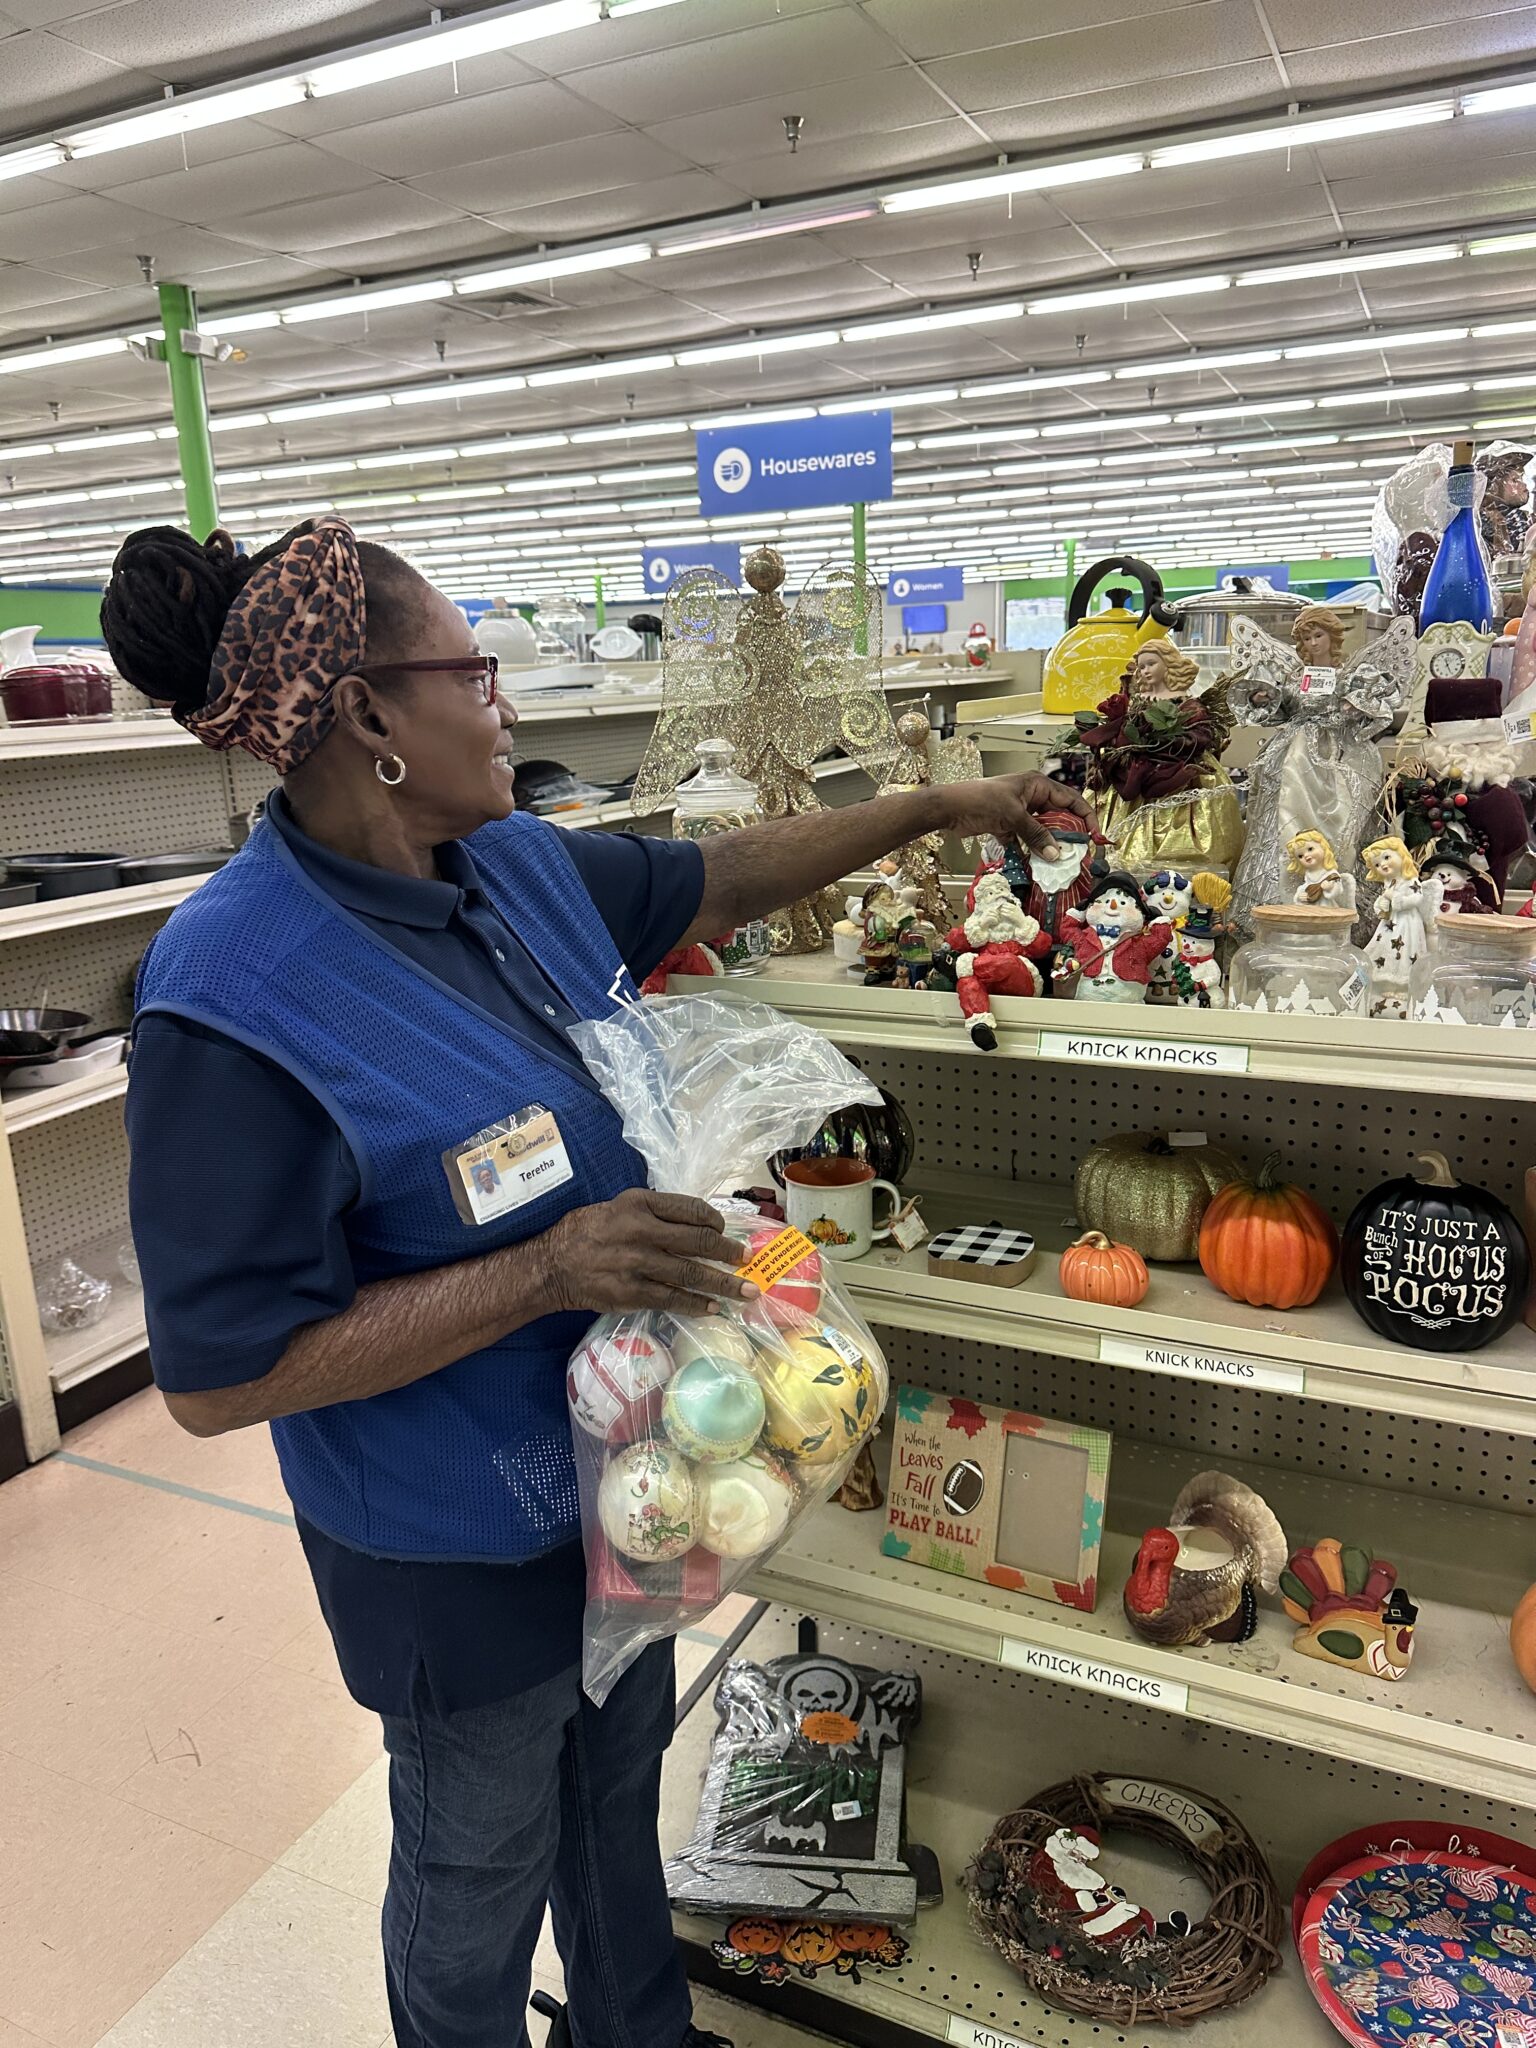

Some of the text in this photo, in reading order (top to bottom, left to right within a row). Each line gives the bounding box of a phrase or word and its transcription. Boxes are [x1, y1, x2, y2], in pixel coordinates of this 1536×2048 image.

[760, 450, 877, 477] Housewares
[912, 581, 944, 593] Women
[1067, 1041, 1217, 1066] KNICK KNACKS
[518, 1158, 555, 1182] Teretha
[1379, 1209, 1500, 1240] IT'S JUST A
[753, 1251, 770, 1268] BAGS
[769, 1240, 785, 1253] WILL
[784, 1230, 795, 1241] NOT
[1373, 1251, 1384, 1260] OF
[1399, 1238, 1507, 1282] HOCUS
[760, 1264, 771, 1274] NO
[765, 1261, 789, 1283] BOLSAS
[1364, 1270, 1507, 1317] POCUS
[1145, 1349, 1254, 1378] KNICK KNACKS
[904, 1430, 941, 1450] When the
[900, 1446, 944, 1471] Leaves
[905, 1472, 936, 1500] Fall
[891, 1492, 941, 1517] It's Time to
[889, 1508, 982, 1547] PLAY BALL!
[1026, 1650, 1161, 1698] KNICK KNACKS
[1121, 1783, 1206, 1834] CHEERS
